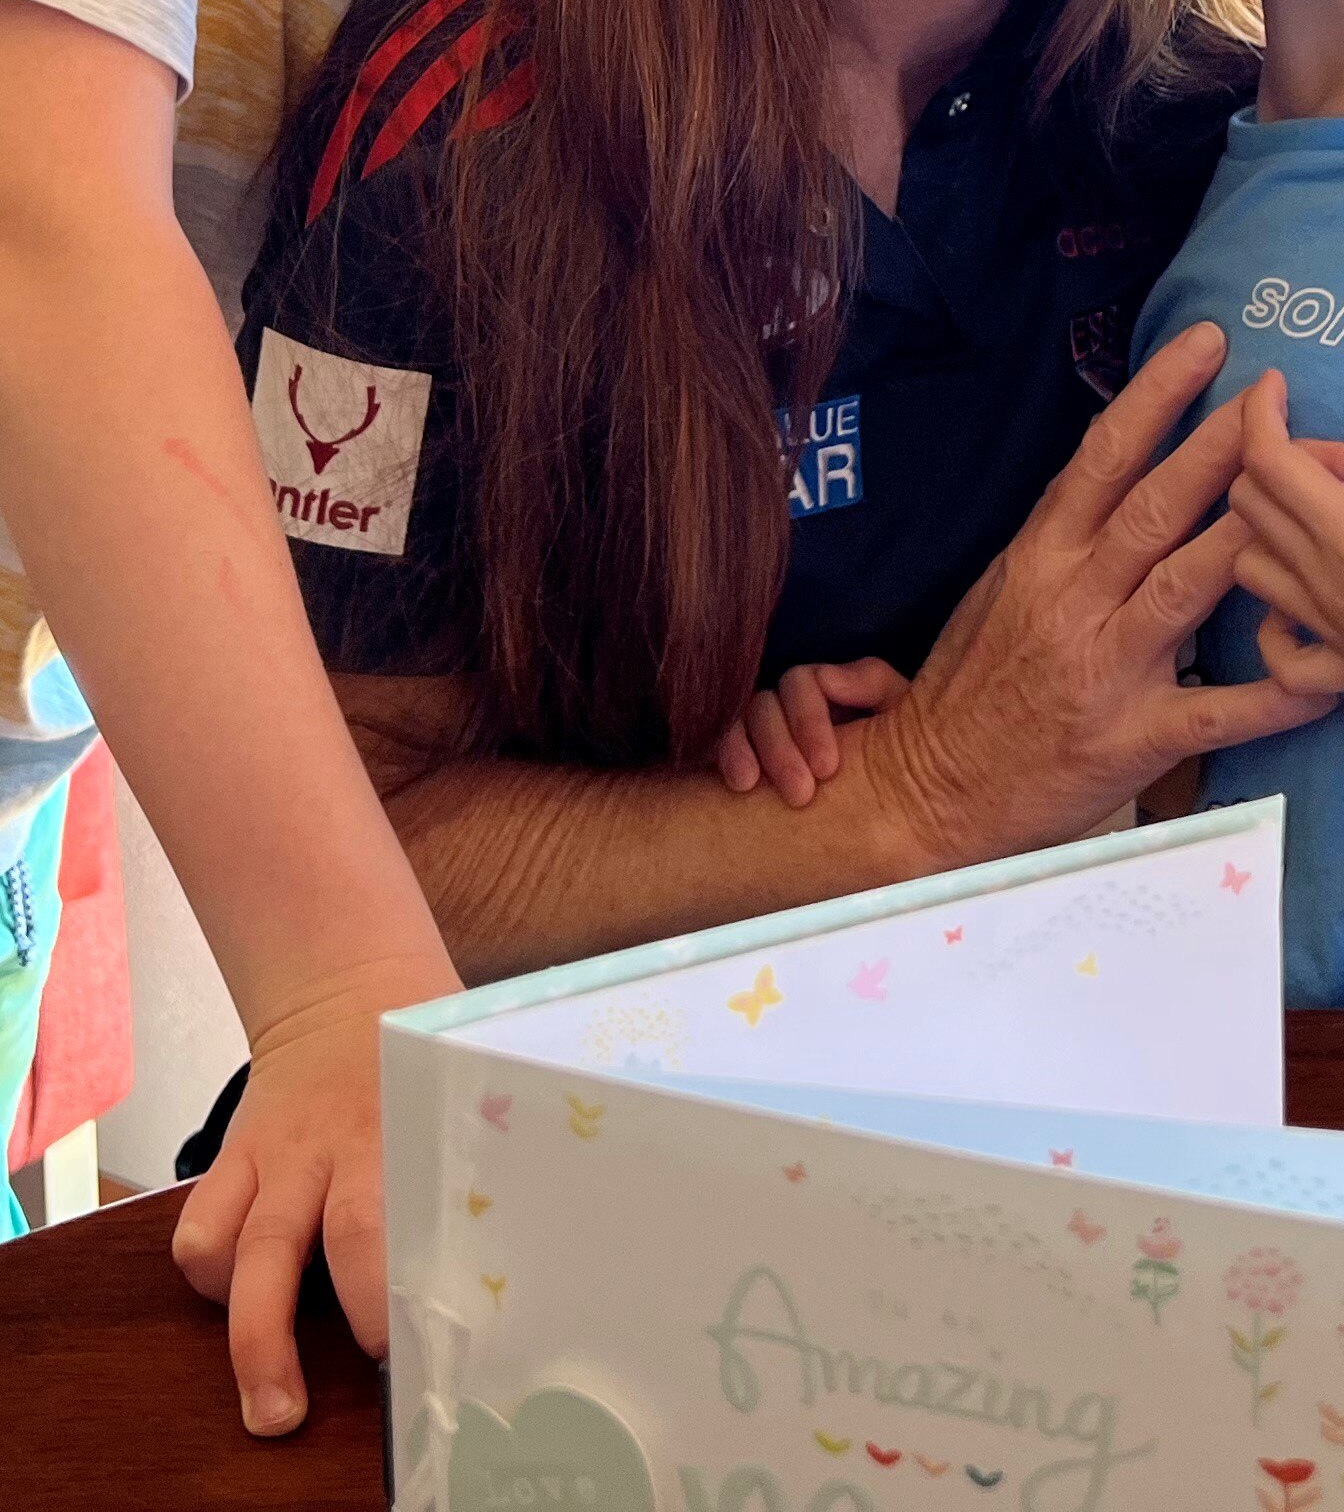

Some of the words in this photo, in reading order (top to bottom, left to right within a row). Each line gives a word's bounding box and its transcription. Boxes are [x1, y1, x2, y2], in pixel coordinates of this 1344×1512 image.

[775, 399, 859, 449] LUE
[269, 477, 383, 533] ntler
[704, 1262, 1158, 1511] Amazing
